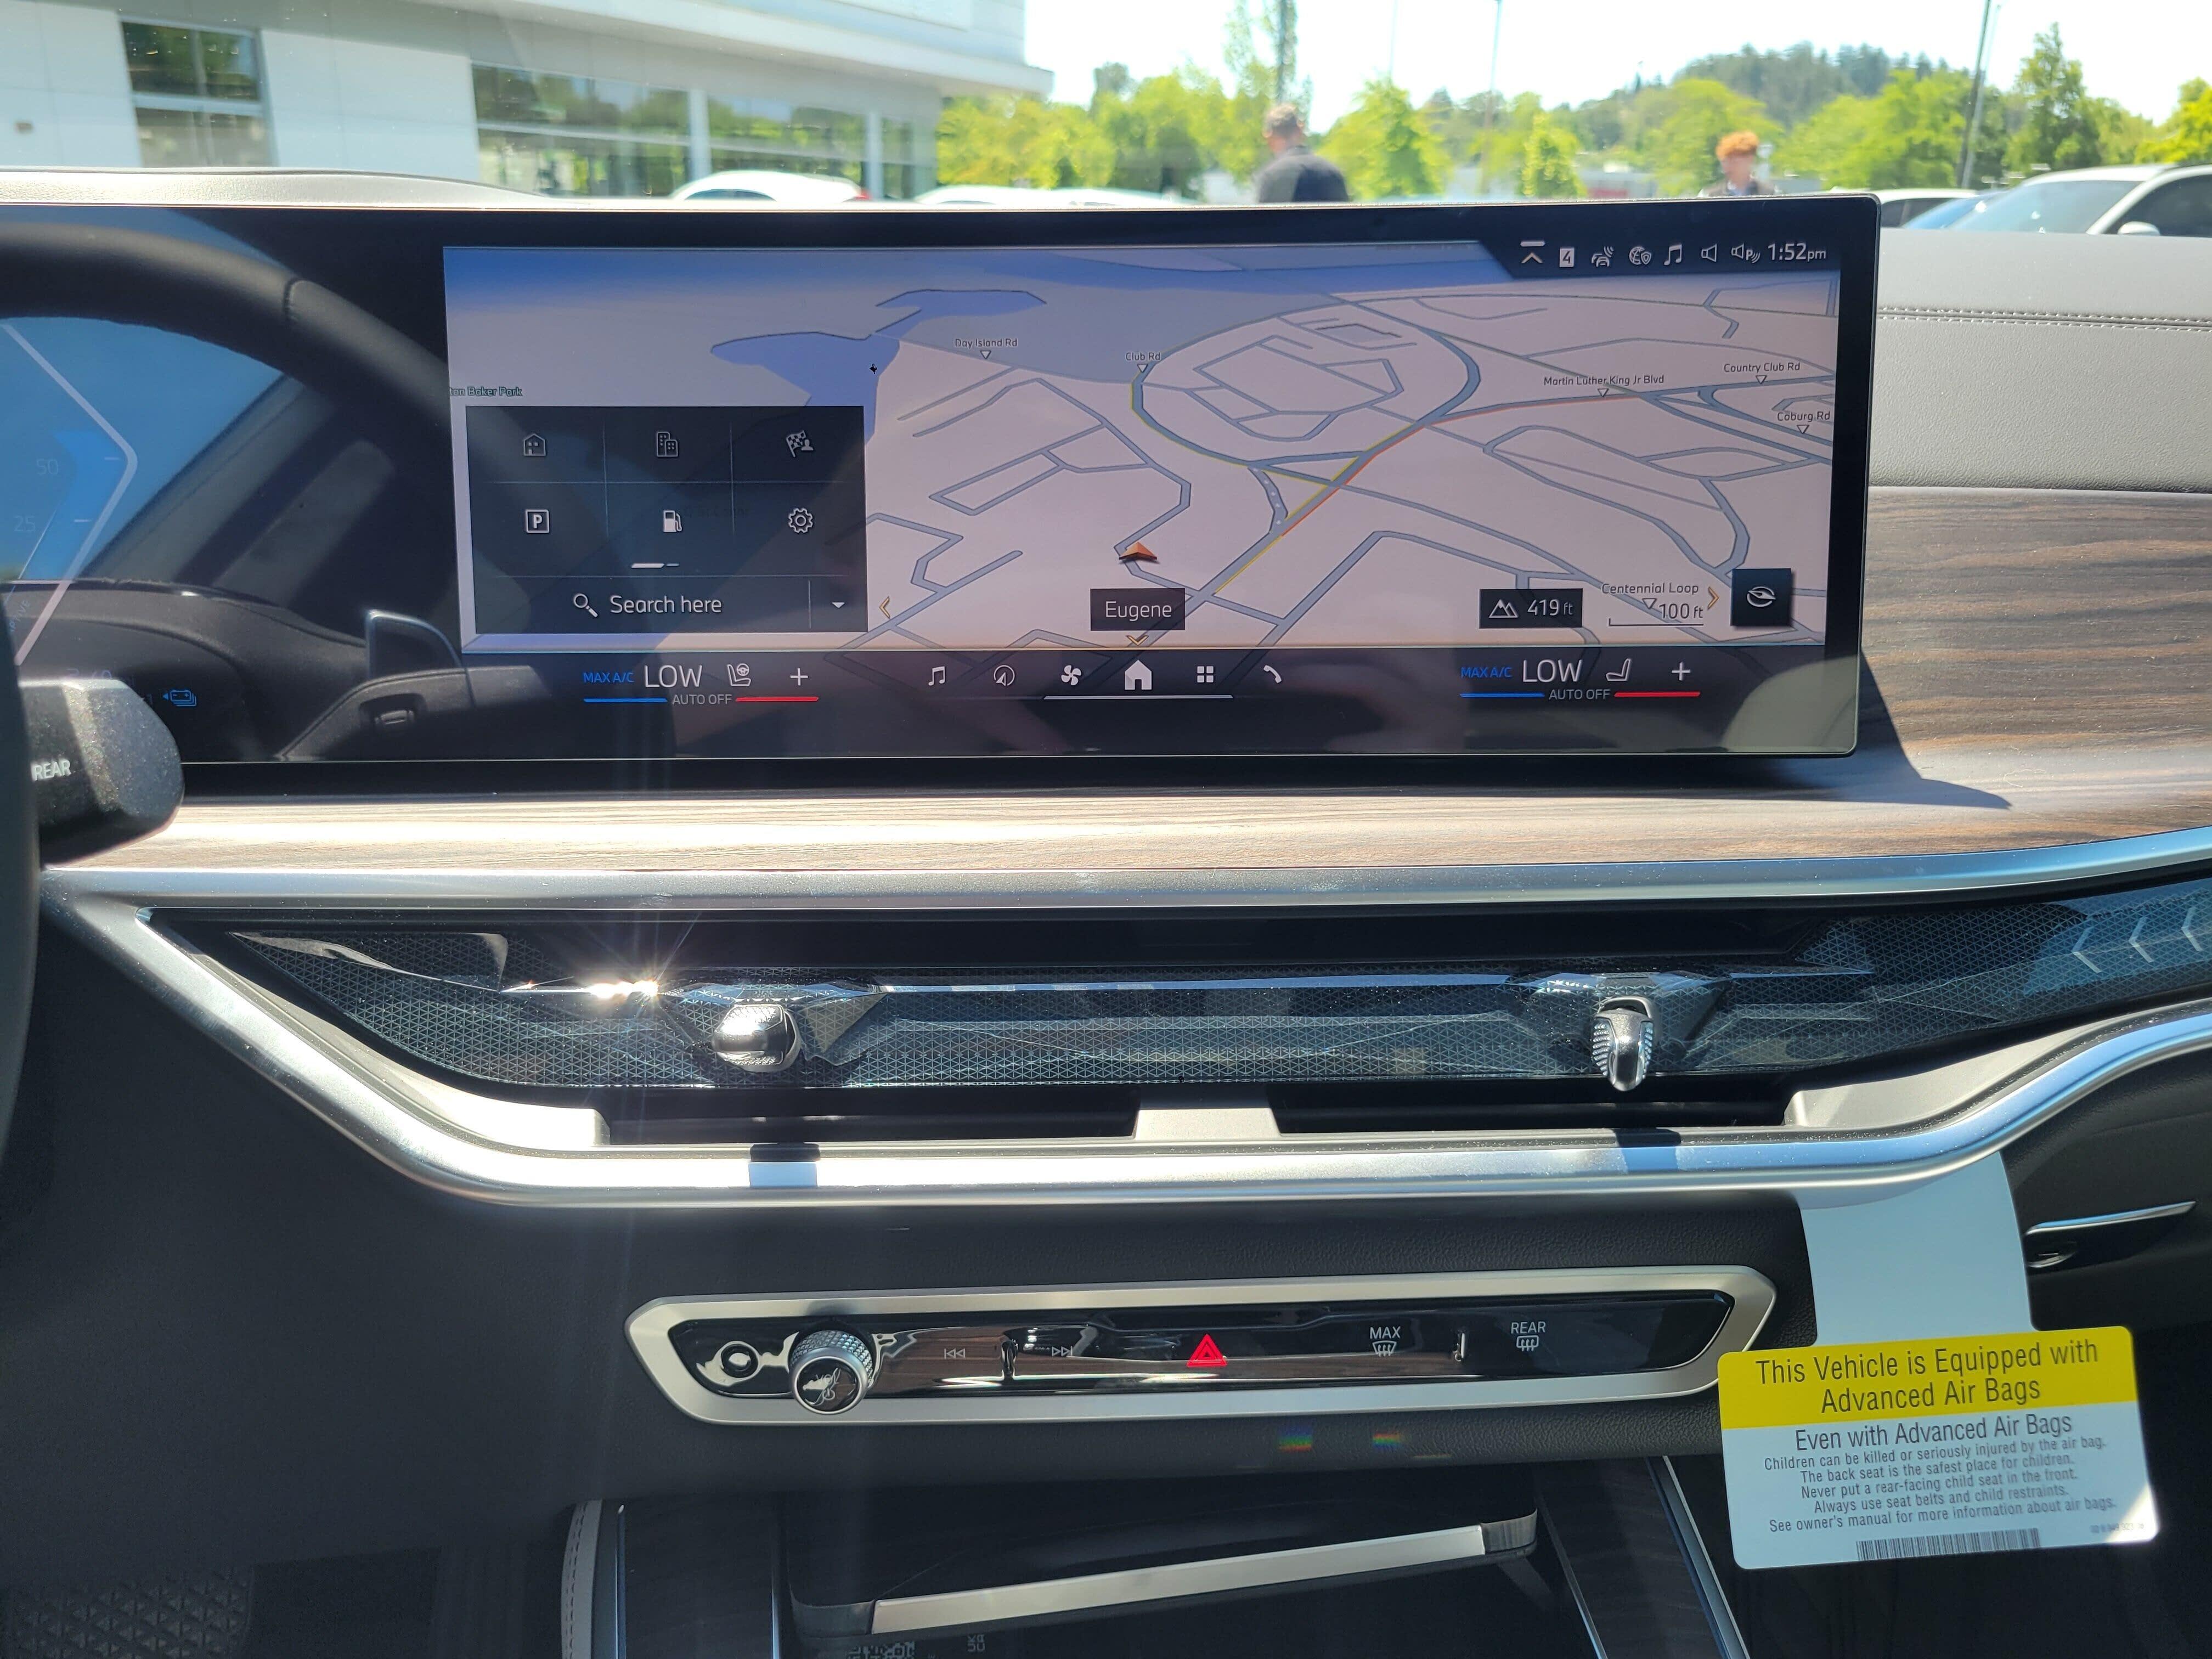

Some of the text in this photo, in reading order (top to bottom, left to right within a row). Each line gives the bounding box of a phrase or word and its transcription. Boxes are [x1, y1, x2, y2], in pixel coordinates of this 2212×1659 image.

[1768, 242, 1826, 262] 1:52pm
[955, 338, 1018, 349] Day Island Rd
[1126, 352, 1160, 361] Club Rd
[1724, 362, 1800, 375] Country Club Rd
[1544, 375, 1664, 387] Martin Luther King Jr Blvd
[467, 386, 498, 397] Baker
[499, 386, 523, 397] Park
[1777, 411, 1830, 423] Coburg Rd
[1601, 583, 1699, 596] Centennial Loop
[610, 595, 723, 614] Search here
[1105, 601, 1172, 622] Eugene
[1527, 599, 1573, 617] 419 ft
[1661, 603, 1703, 619] 100 ft
[584, 672, 634, 683] MAX A/C
[644, 664, 702, 687] LOW
[1461, 667, 1513, 678] MAX A/C
[1522, 659, 1583, 682] LOW
[672, 694, 732, 705] AUTO OFF
[1549, 689, 1611, 700] AUTO OFF
[31, 759, 71, 781] REAR
[1370, 1327, 1401, 1339] MAX
[1511, 1321, 1545, 1334] REAR
[1756, 1339, 2098, 1384] This Vehicle is Equipped with
[1821, 1378, 2040, 1413] Advanced Air Bags
[1796, 1413, 2072, 1451] Even with Advanced Air Bags
[1764, 1436, 2107, 1470] Children can be killed or seriously injured by the air bag.
[1800, 1453, 2075, 1483] The back seat is the safest place for children.
[1801, 1468, 2078, 1499] Never put a rear-facing child seat in the front.
[1814, 1483, 2069, 1514] Always use seat belts and child restraints.
[1769, 1496, 2116, 1532] See owner's manual for more information about air bags.
